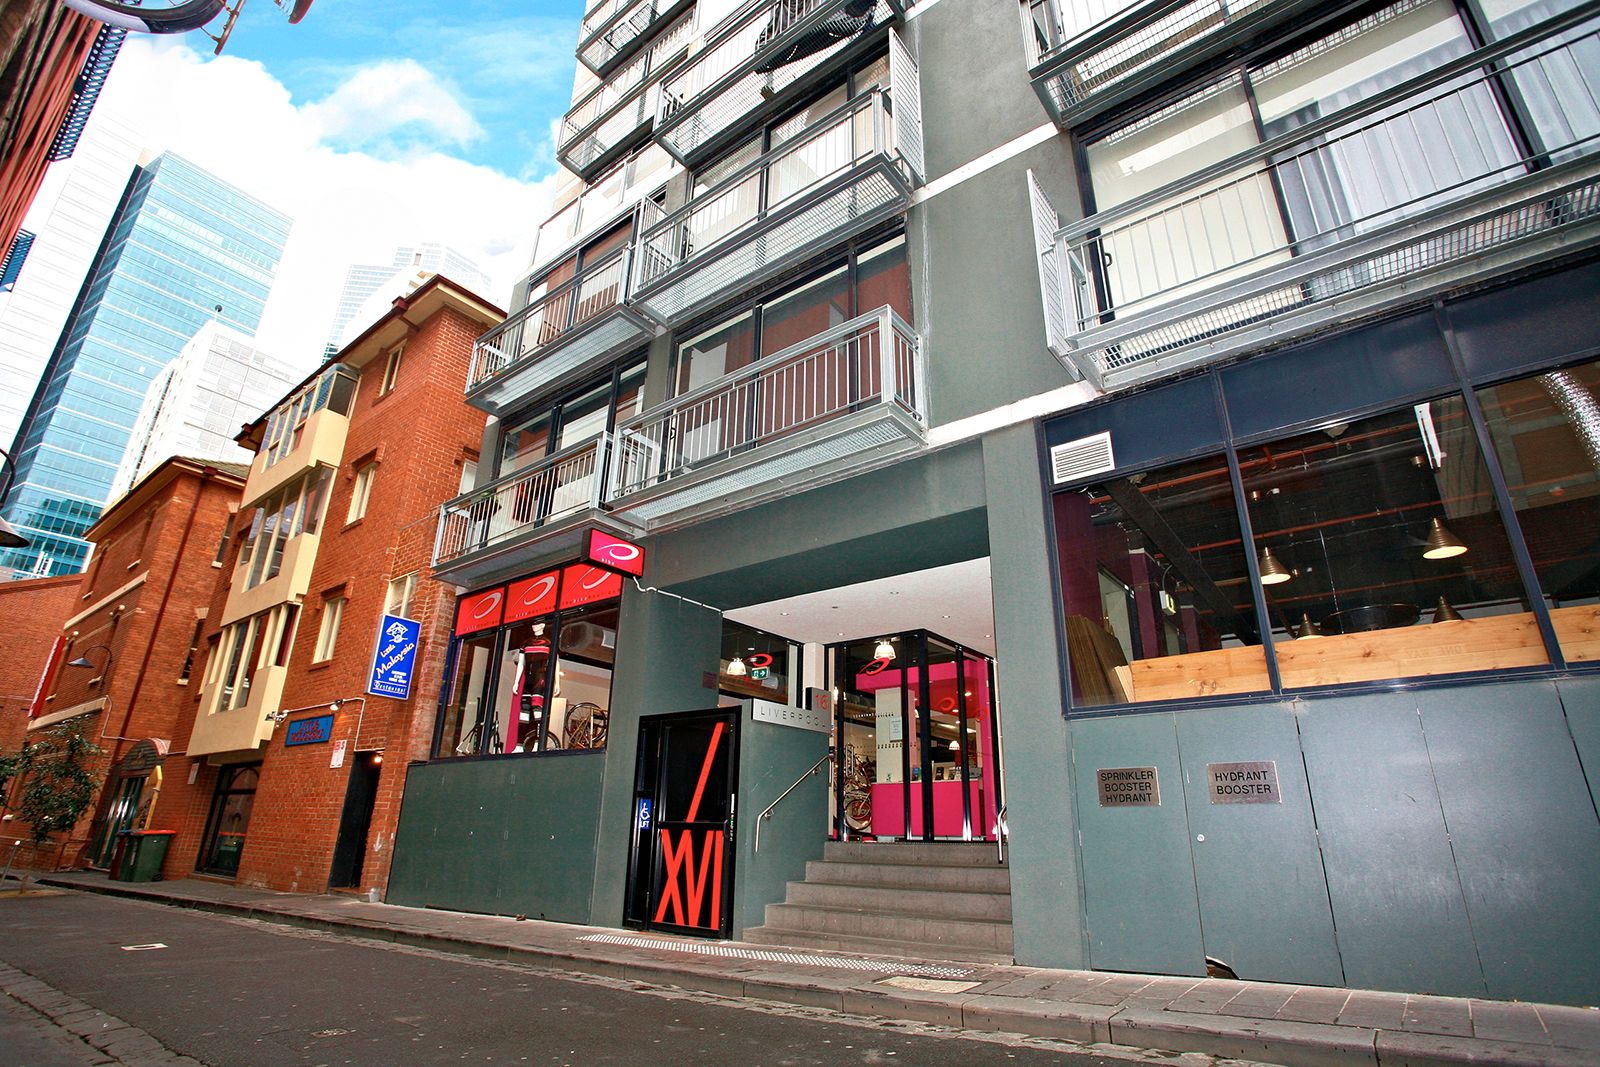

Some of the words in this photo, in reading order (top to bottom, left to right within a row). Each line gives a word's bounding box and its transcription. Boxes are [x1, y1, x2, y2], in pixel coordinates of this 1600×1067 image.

[376, 642, 415, 679] Malaysia
[815, 693, 829, 710] 16
[1100, 770, 1154, 782] SPRINKLER
[1215, 771, 1268, 782] HYDRANT
[1104, 782, 1152, 792] BOOSTER
[1217, 784, 1272, 795] BOOSTER
[1106, 793, 1152, 803] HYDRANT
